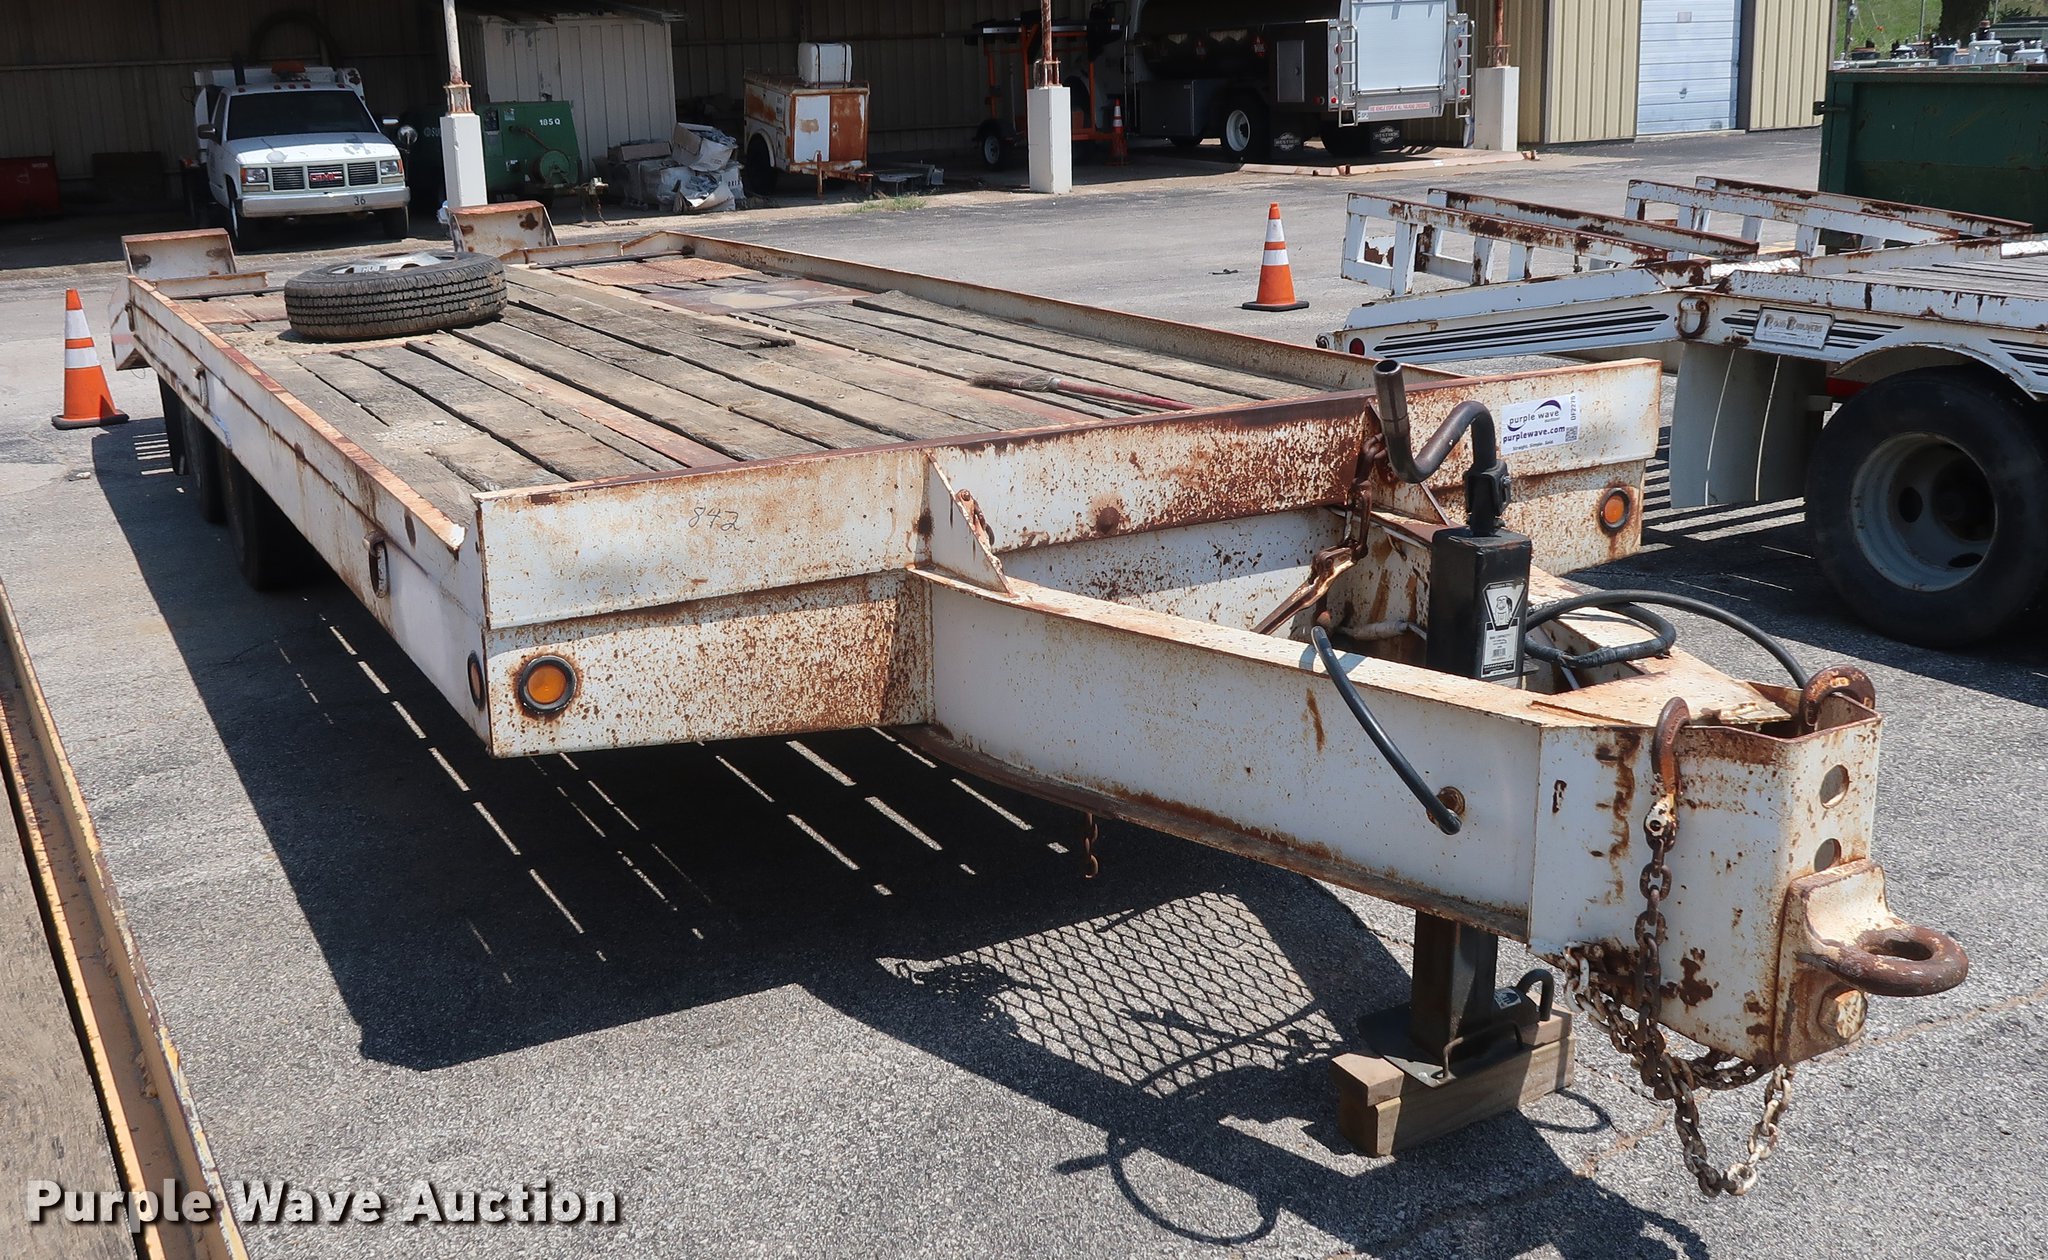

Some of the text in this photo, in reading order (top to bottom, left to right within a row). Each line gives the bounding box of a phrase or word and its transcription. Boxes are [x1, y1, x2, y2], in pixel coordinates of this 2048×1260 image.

[310, 172, 343, 182] GMC
[354, 195, 366, 206] 36
[1509, 410, 1559, 425] purple wave
[1503, 426, 1565, 444] purplewave.com
[688, 506, 741, 531] 842
